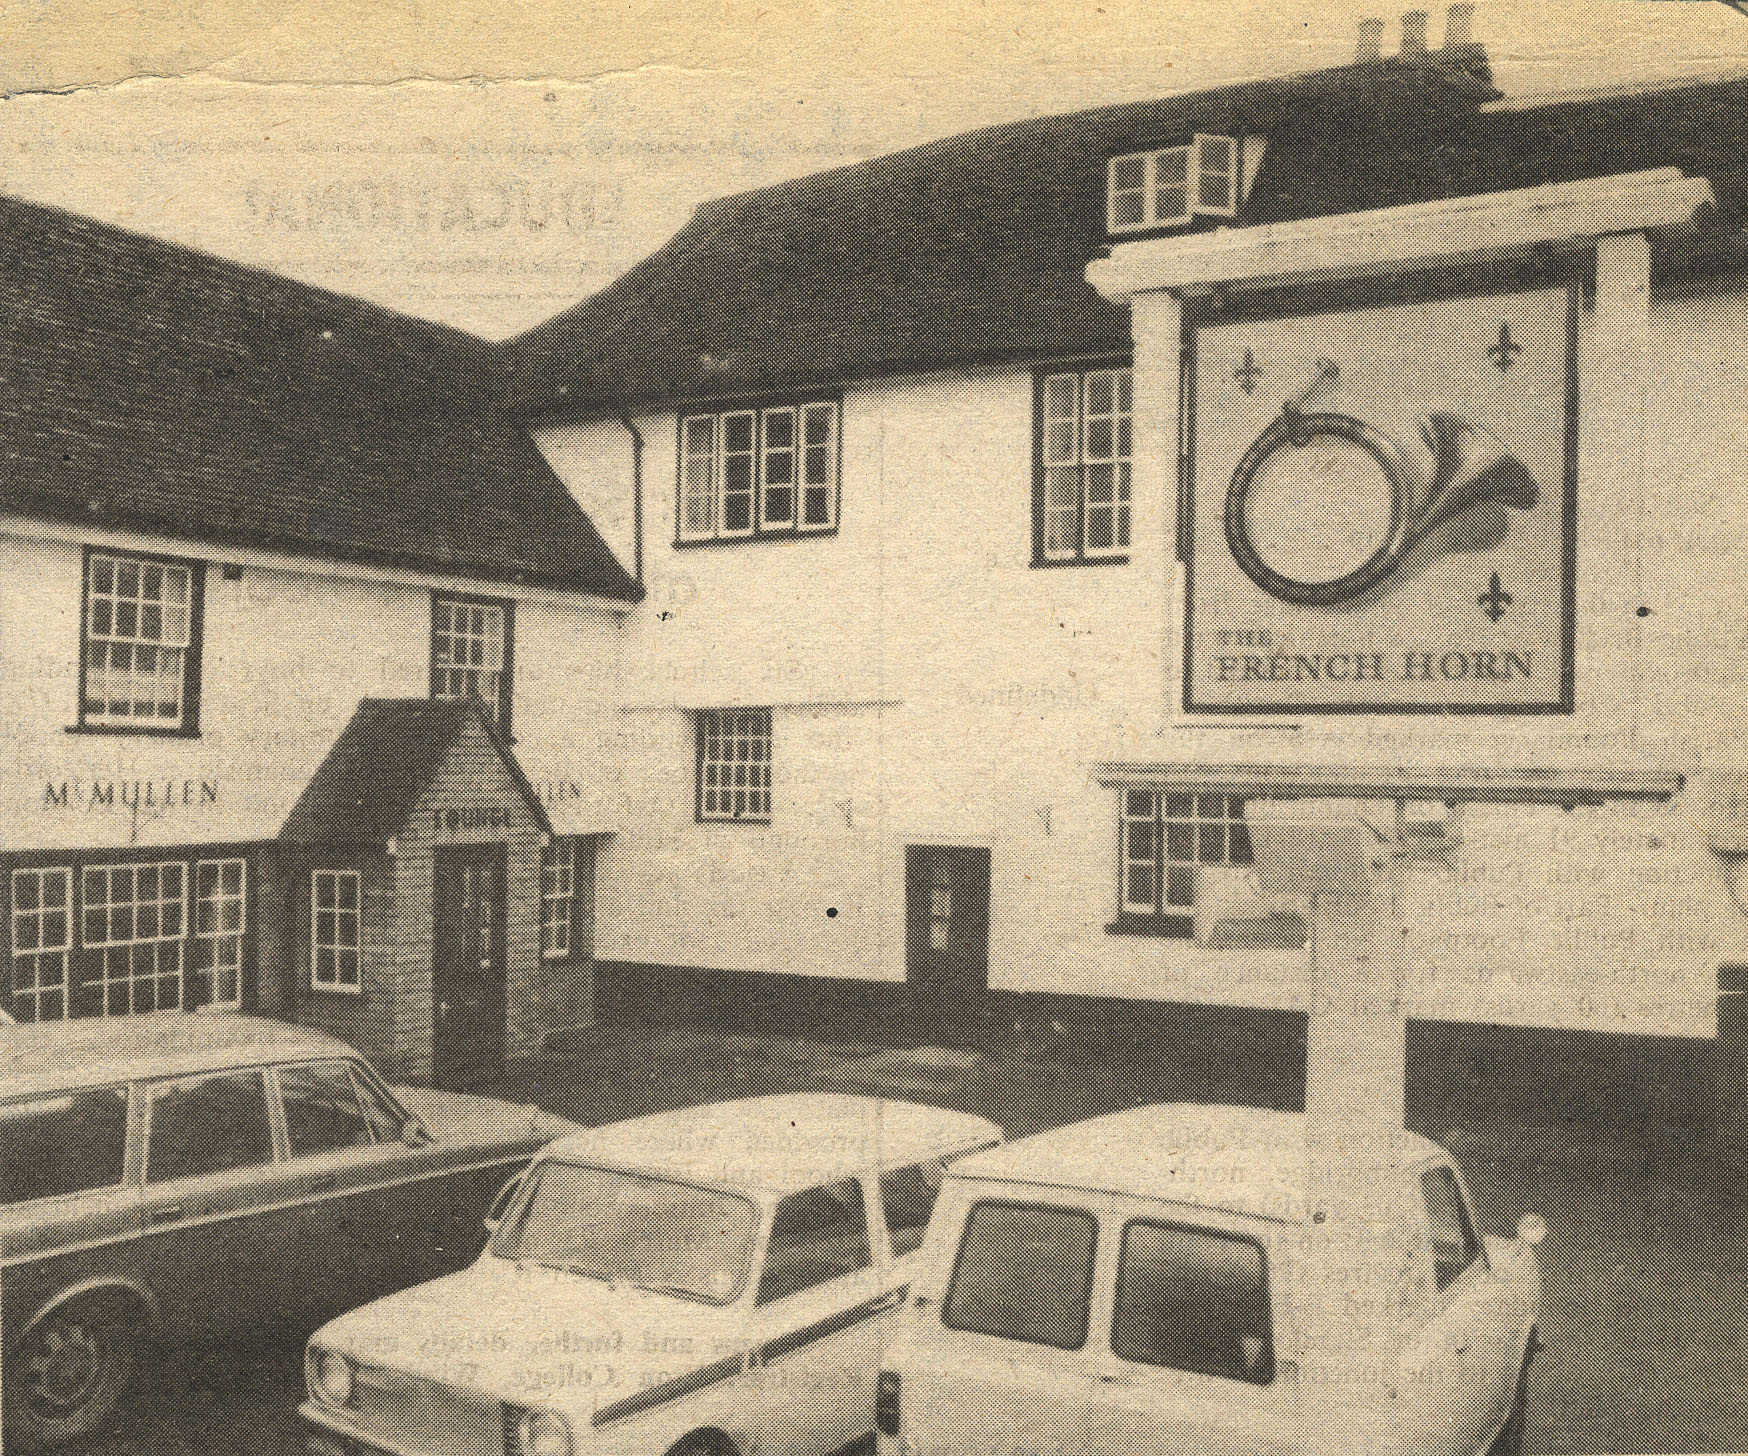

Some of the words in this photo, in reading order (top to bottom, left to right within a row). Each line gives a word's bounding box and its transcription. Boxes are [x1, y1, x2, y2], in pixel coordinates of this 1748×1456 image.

[1215, 629, 1273, 648] THE
[1216, 651, 1385, 682] FRENCH
[1401, 648, 1535, 682] HORN
